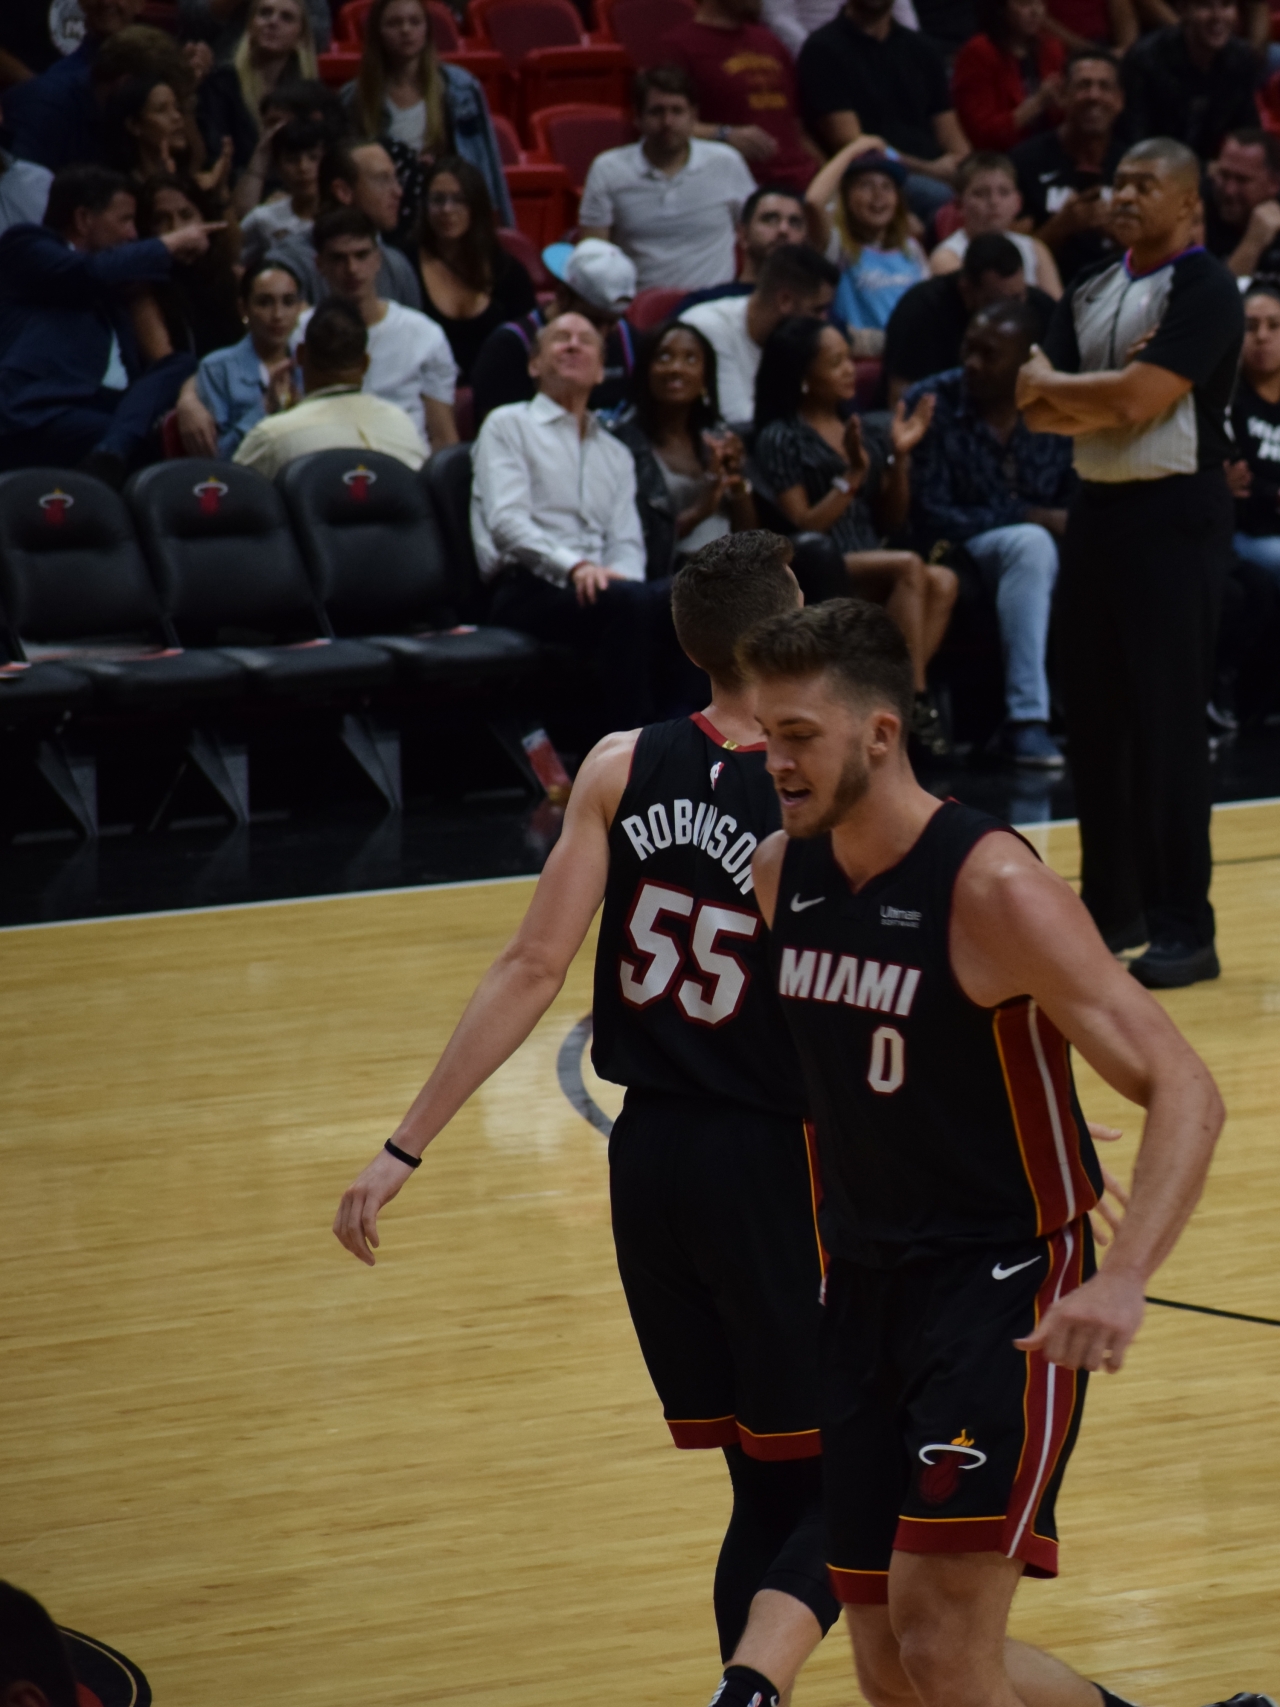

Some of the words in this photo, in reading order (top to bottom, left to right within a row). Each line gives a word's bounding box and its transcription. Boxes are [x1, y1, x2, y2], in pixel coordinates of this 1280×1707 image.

[618, 879, 760, 1027] 55
[779, 947, 922, 1017] MIAMI
[867, 1025, 905, 1094] 0
